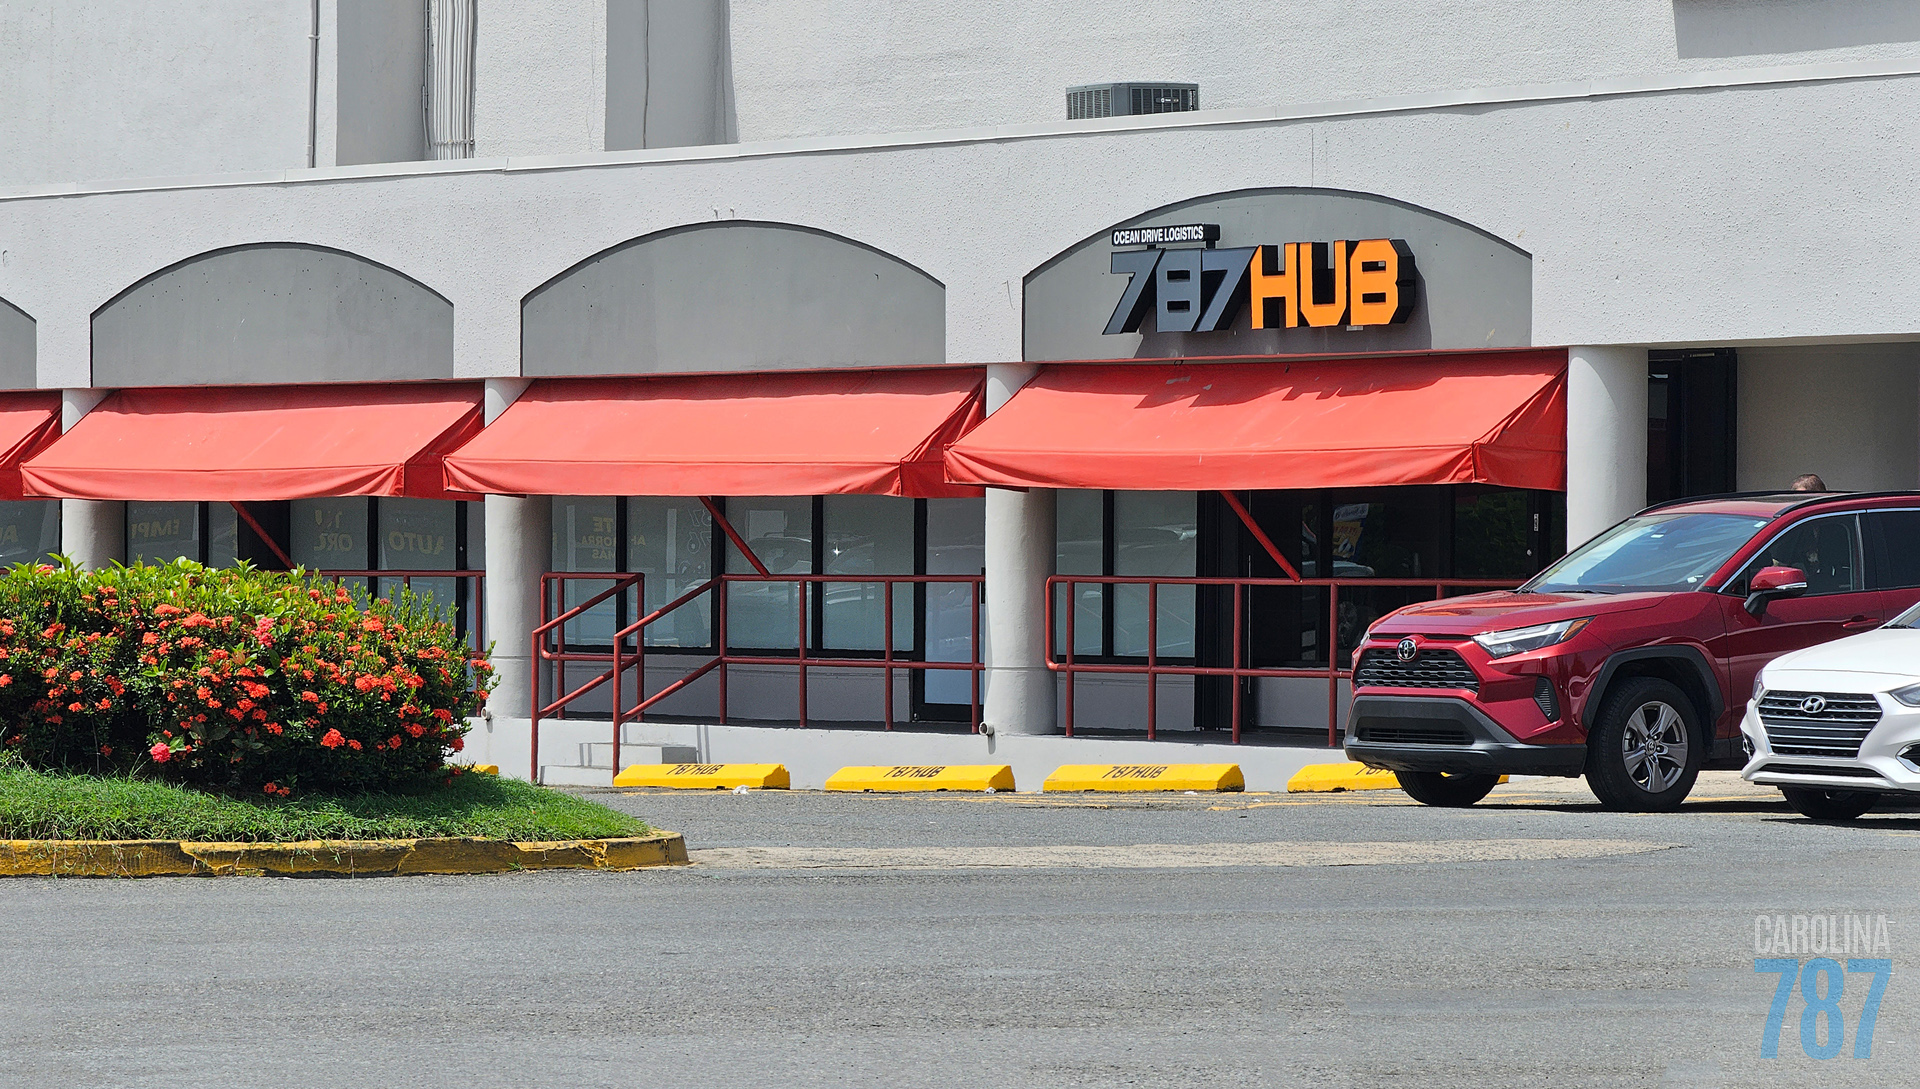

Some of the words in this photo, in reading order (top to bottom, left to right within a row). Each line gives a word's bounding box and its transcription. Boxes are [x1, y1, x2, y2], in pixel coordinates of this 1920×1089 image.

[1113, 230, 1140, 245] OCEAN
[1141, 227, 1163, 243] DRIVE
[1164, 225, 1204, 241] LOGISTICS
[1102, 766, 1168, 779] 787HUB
